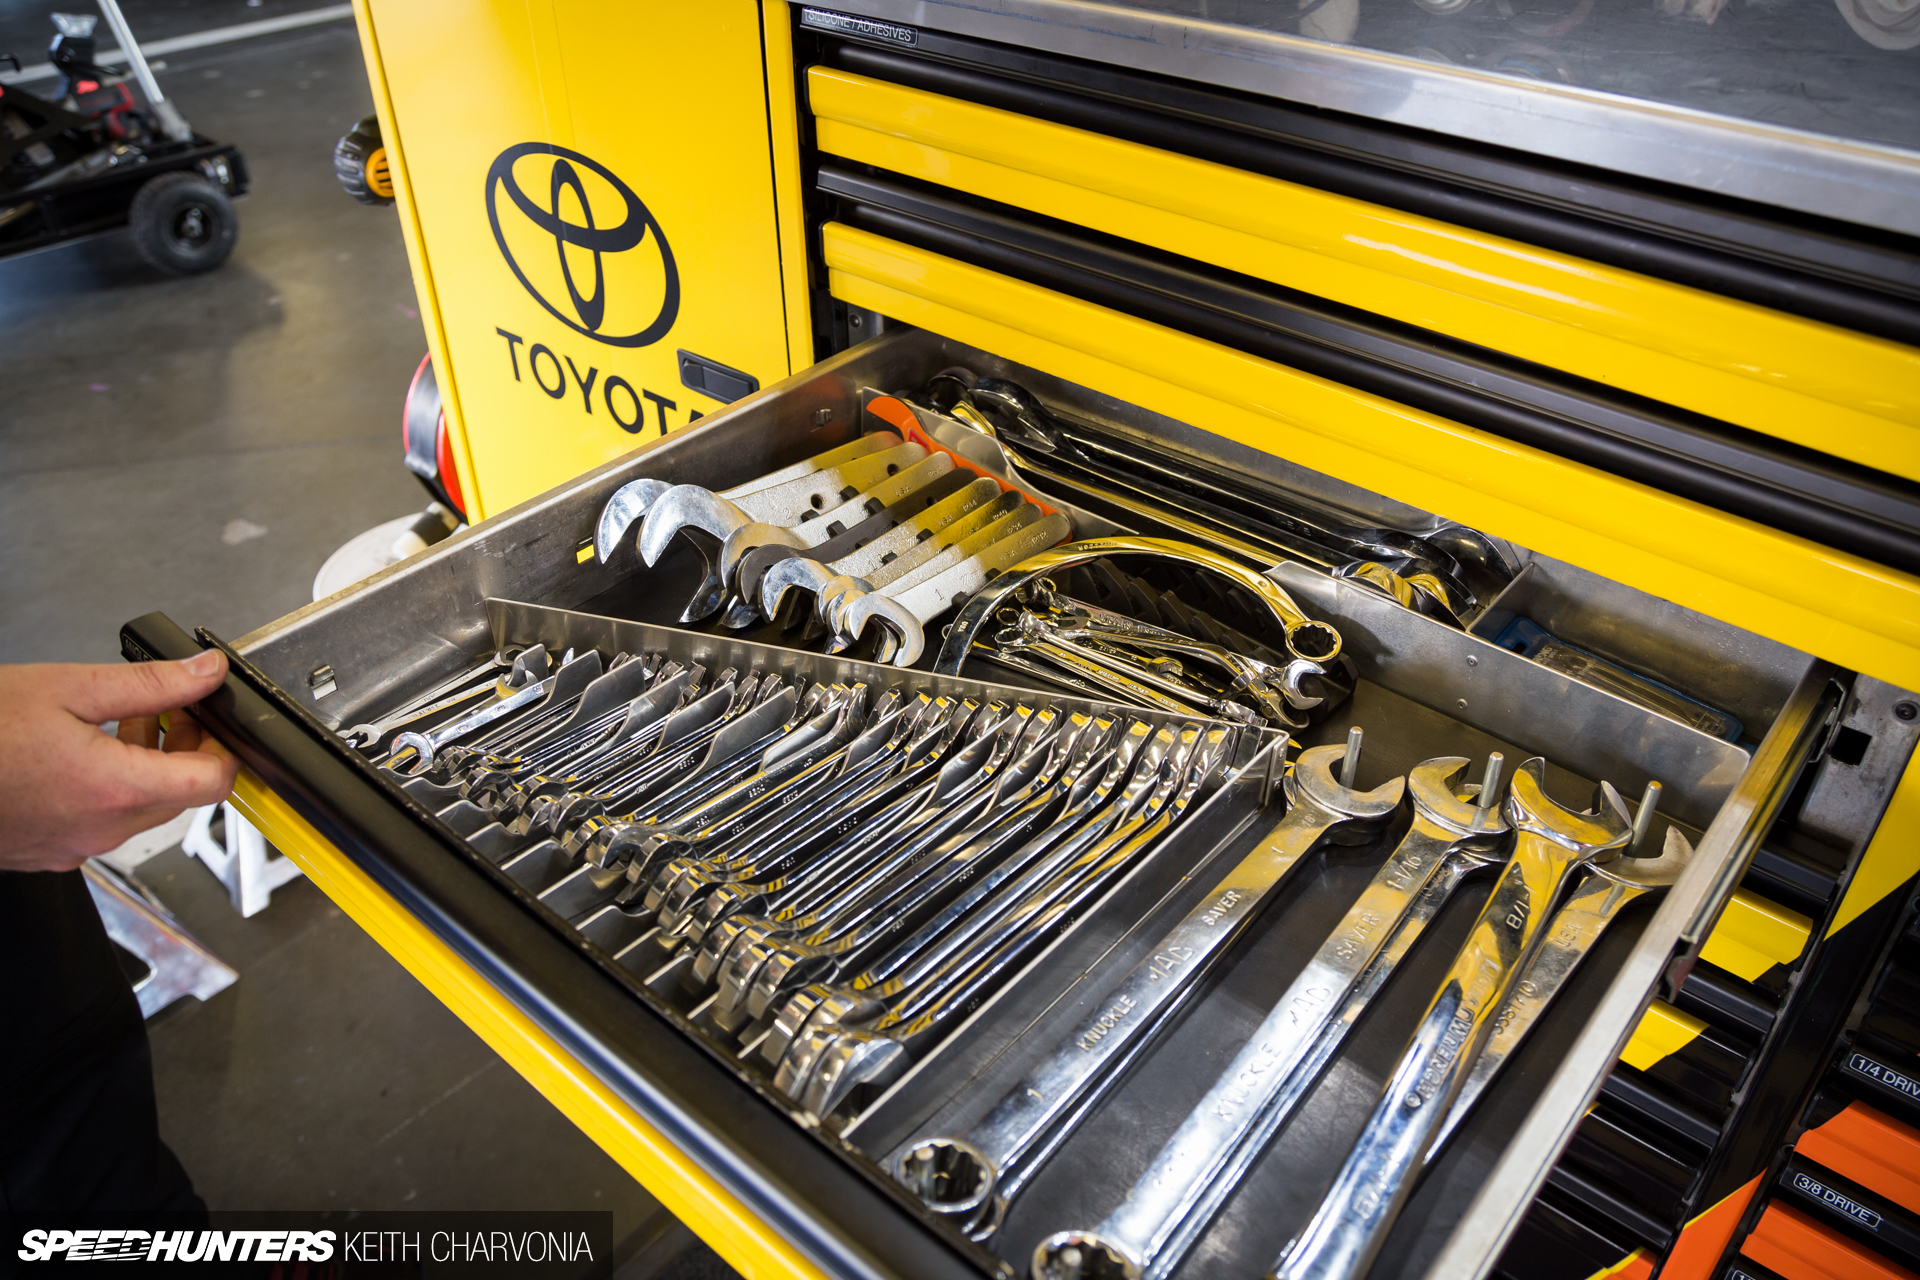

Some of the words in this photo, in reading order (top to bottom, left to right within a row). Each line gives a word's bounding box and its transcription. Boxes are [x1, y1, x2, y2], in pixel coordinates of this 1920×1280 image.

[807, 9, 850, 29] SILICONE
[857, 19, 912, 42] ADHESIVES
[495, 326, 705, 436] TOYOT
[1551, 923, 1584, 948] USA
[1076, 993, 1138, 1052] KNUCKLE
[1150, 946, 1195, 988] MAC
[1201, 889, 1243, 926] SAVER
[1211, 1042, 1282, 1123] KNUCKLE
[1336, 912, 1381, 960] SAVER
[1858, 1058, 1881, 1077] 1/4
[1882, 1070, 1920, 1097] DRIV
[1798, 1176, 1822, 1196] 3/8
[1823, 1189, 1871, 1222] DRIVE
